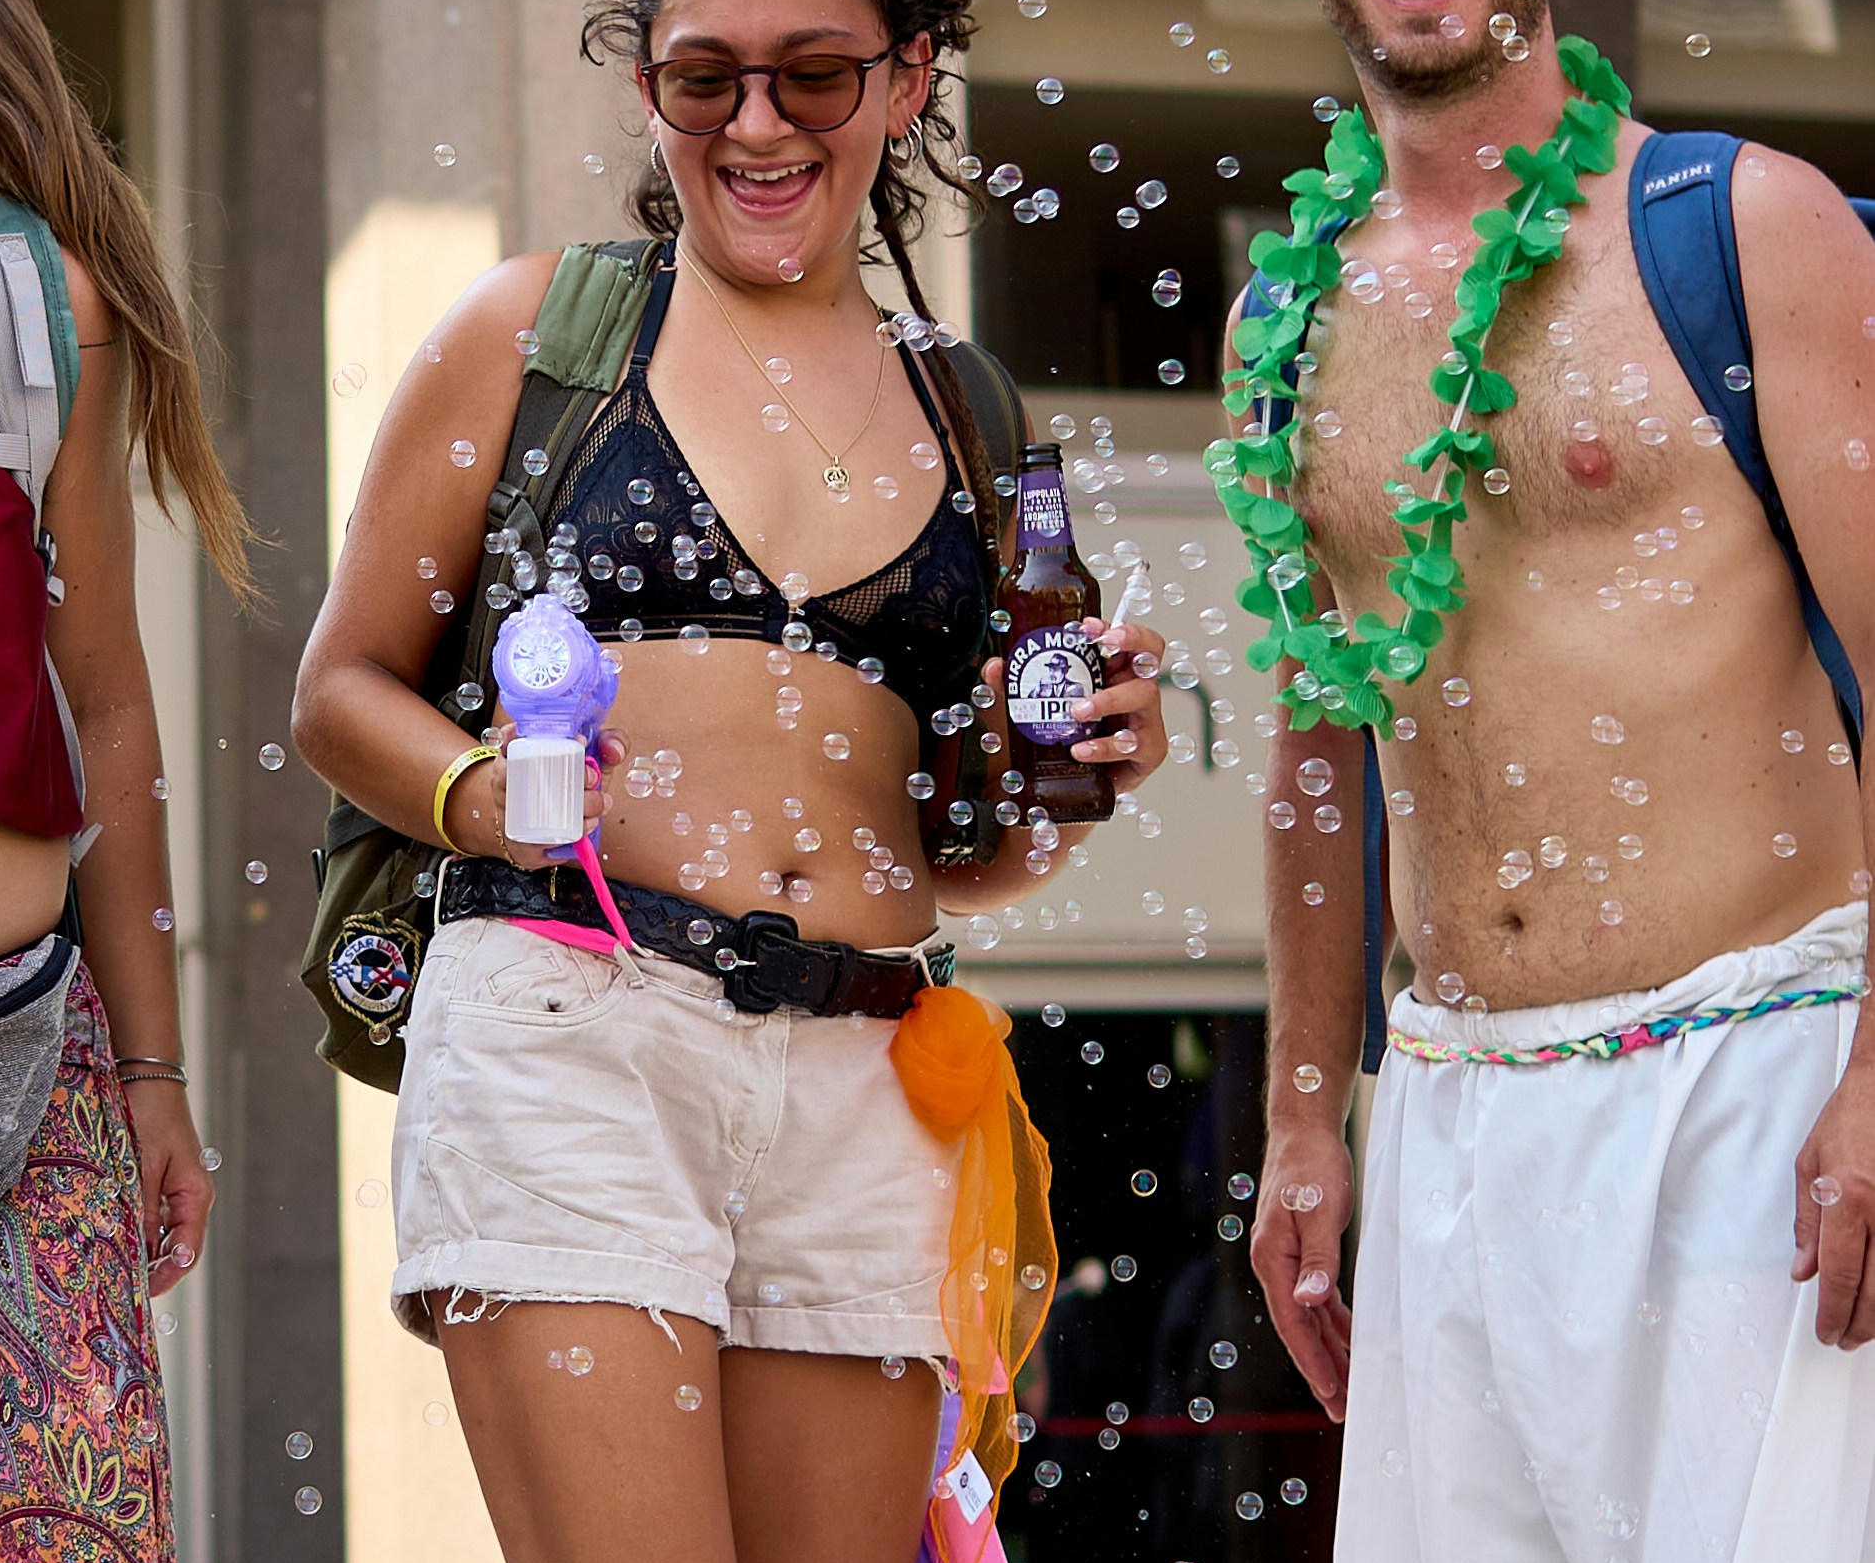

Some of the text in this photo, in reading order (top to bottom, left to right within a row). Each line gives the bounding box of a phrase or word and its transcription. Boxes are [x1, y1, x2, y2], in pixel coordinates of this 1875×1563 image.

[1644, 164, 1713, 195] PANINI
[1008, 638, 1041, 695] BIRRA
[345, 937, 404, 967] STAR LINE
